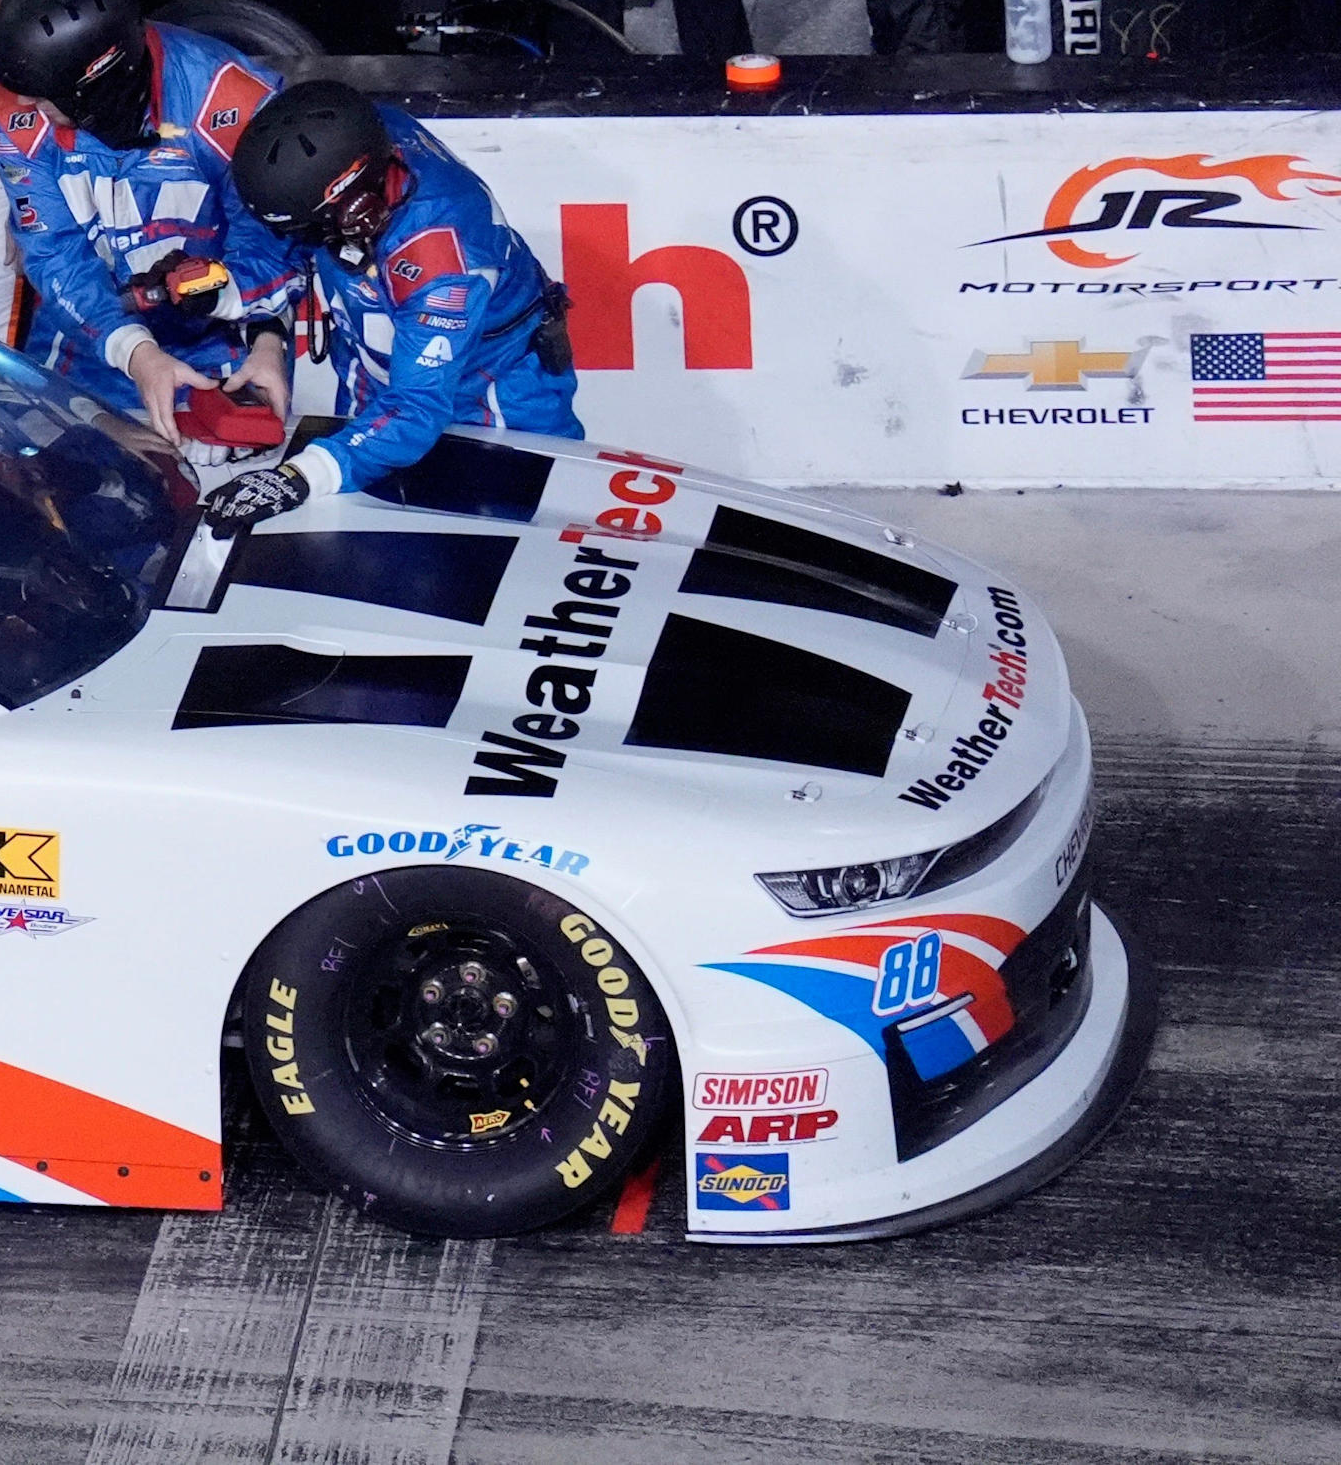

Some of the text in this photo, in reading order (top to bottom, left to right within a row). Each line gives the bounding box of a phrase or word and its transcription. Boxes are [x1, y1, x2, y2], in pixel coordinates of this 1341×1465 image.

[958, 277, 1341, 297] MOTORSPORT
[960, 406, 1156, 426] CHEVROLET
[464, 450, 684, 799] WeatherTech
[326, 823, 590, 877] GOODYEAR
[871, 928, 943, 1018] 88
[266, 977, 316, 1116] EAGLE
[555, 912, 646, 1190] GOODYEAR
[701, 1074, 819, 1106] SIMPSON
[473, 1113, 505, 1129] AERO
[696, 1109, 839, 1142] ARP
[699, 1174, 787, 1192] SUNOCO
